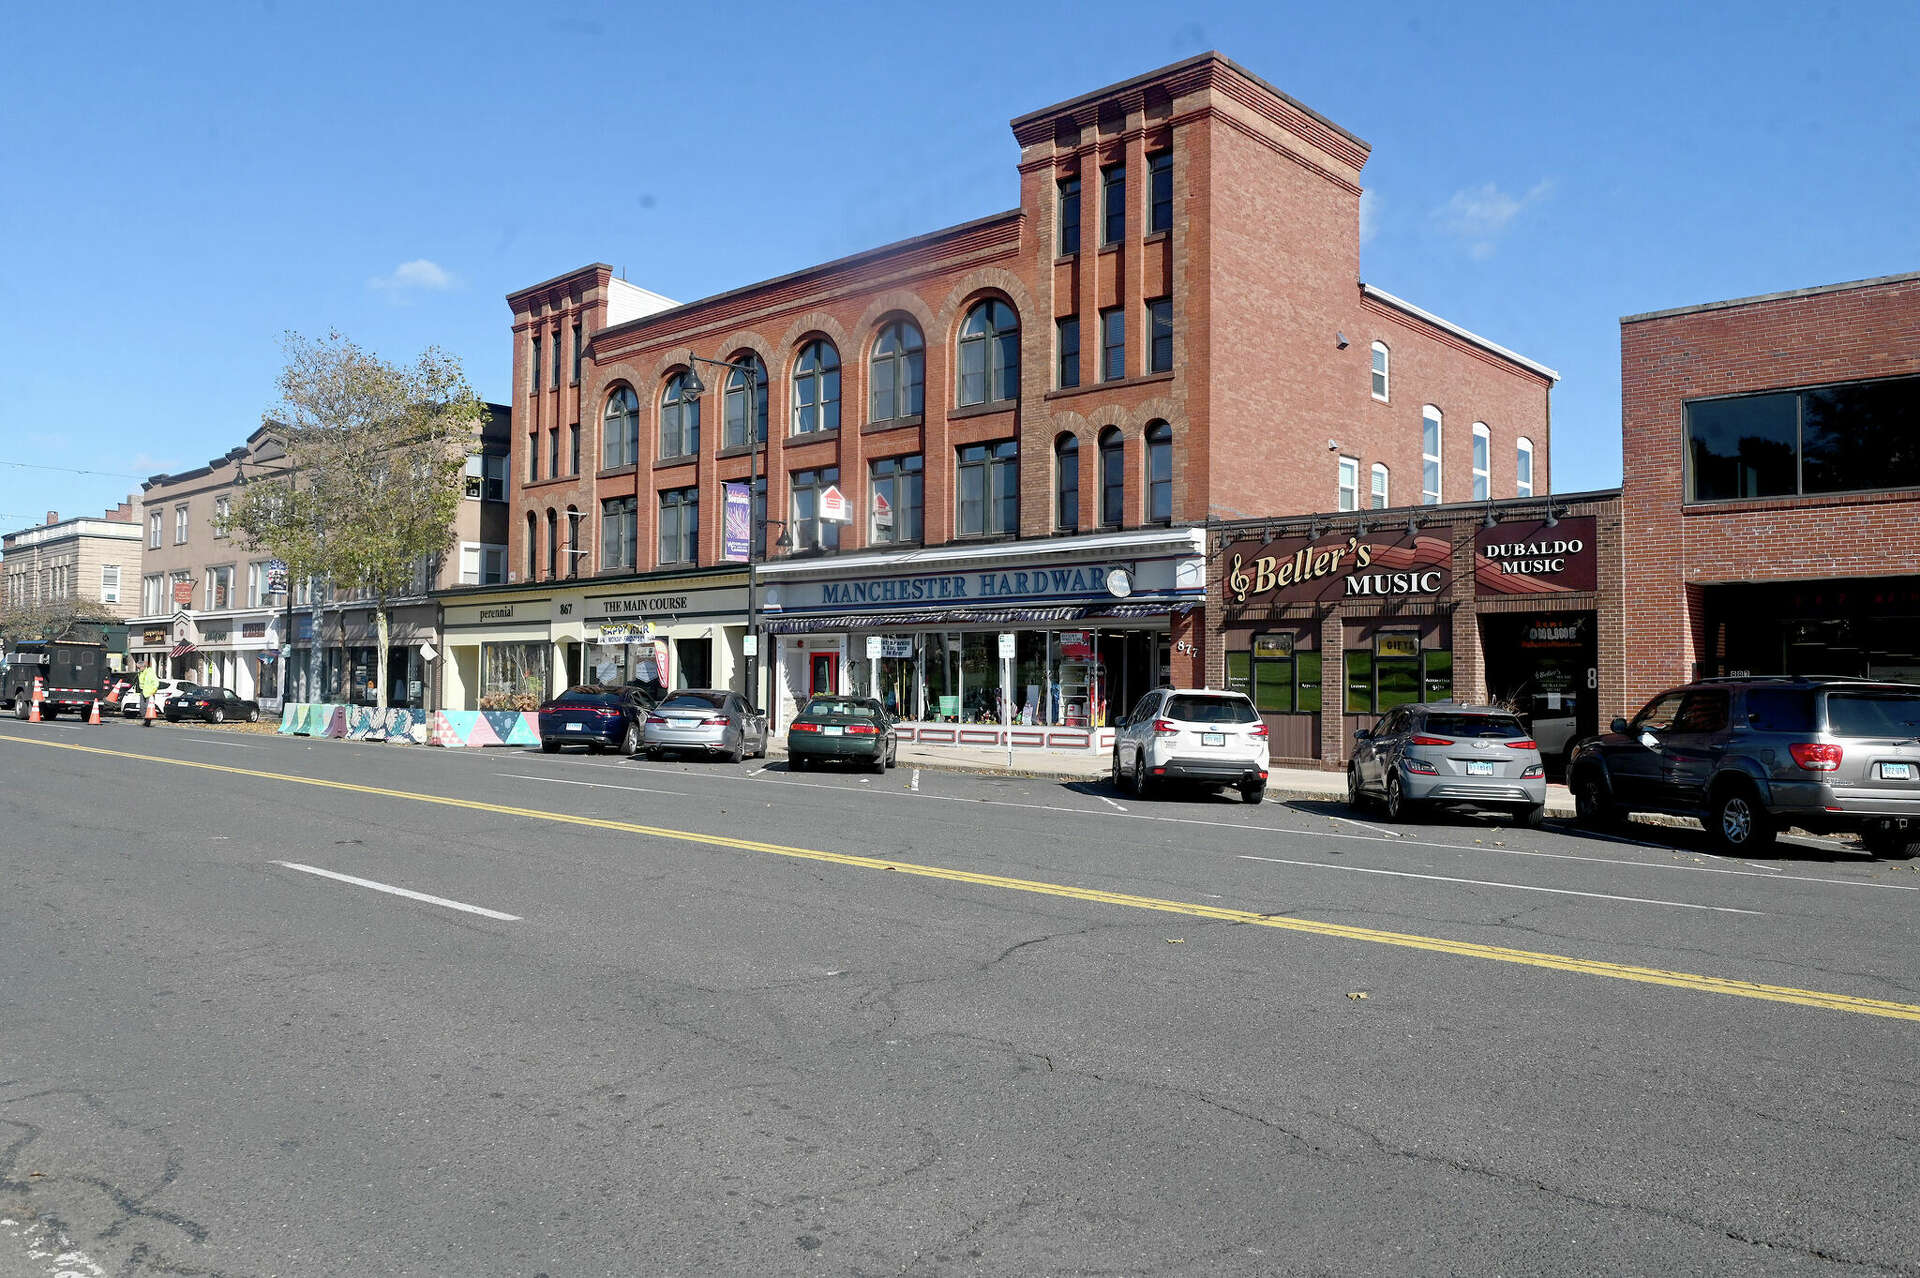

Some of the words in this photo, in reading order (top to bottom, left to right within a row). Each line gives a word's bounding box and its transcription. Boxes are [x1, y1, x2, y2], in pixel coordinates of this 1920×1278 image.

[1486, 539, 1583, 558] DUBALDO
[1253, 537, 1371, 595] Beller's
[1502, 558, 1565, 574] MUSIC
[822, 577, 966, 604] MANCHESTER
[979, 567, 1114, 596] HARDWAR
[1346, 571, 1441, 596] MUSIC
[559, 603, 573, 615] 867
[603, 601, 622, 613] THE
[623, 599, 648, 612] MAIN
[649, 596, 687, 611] COURSE
[479, 605, 514, 622] perennial
[1529, 627, 1577, 640] ONLINE
[1177, 640, 1199, 658] 877
